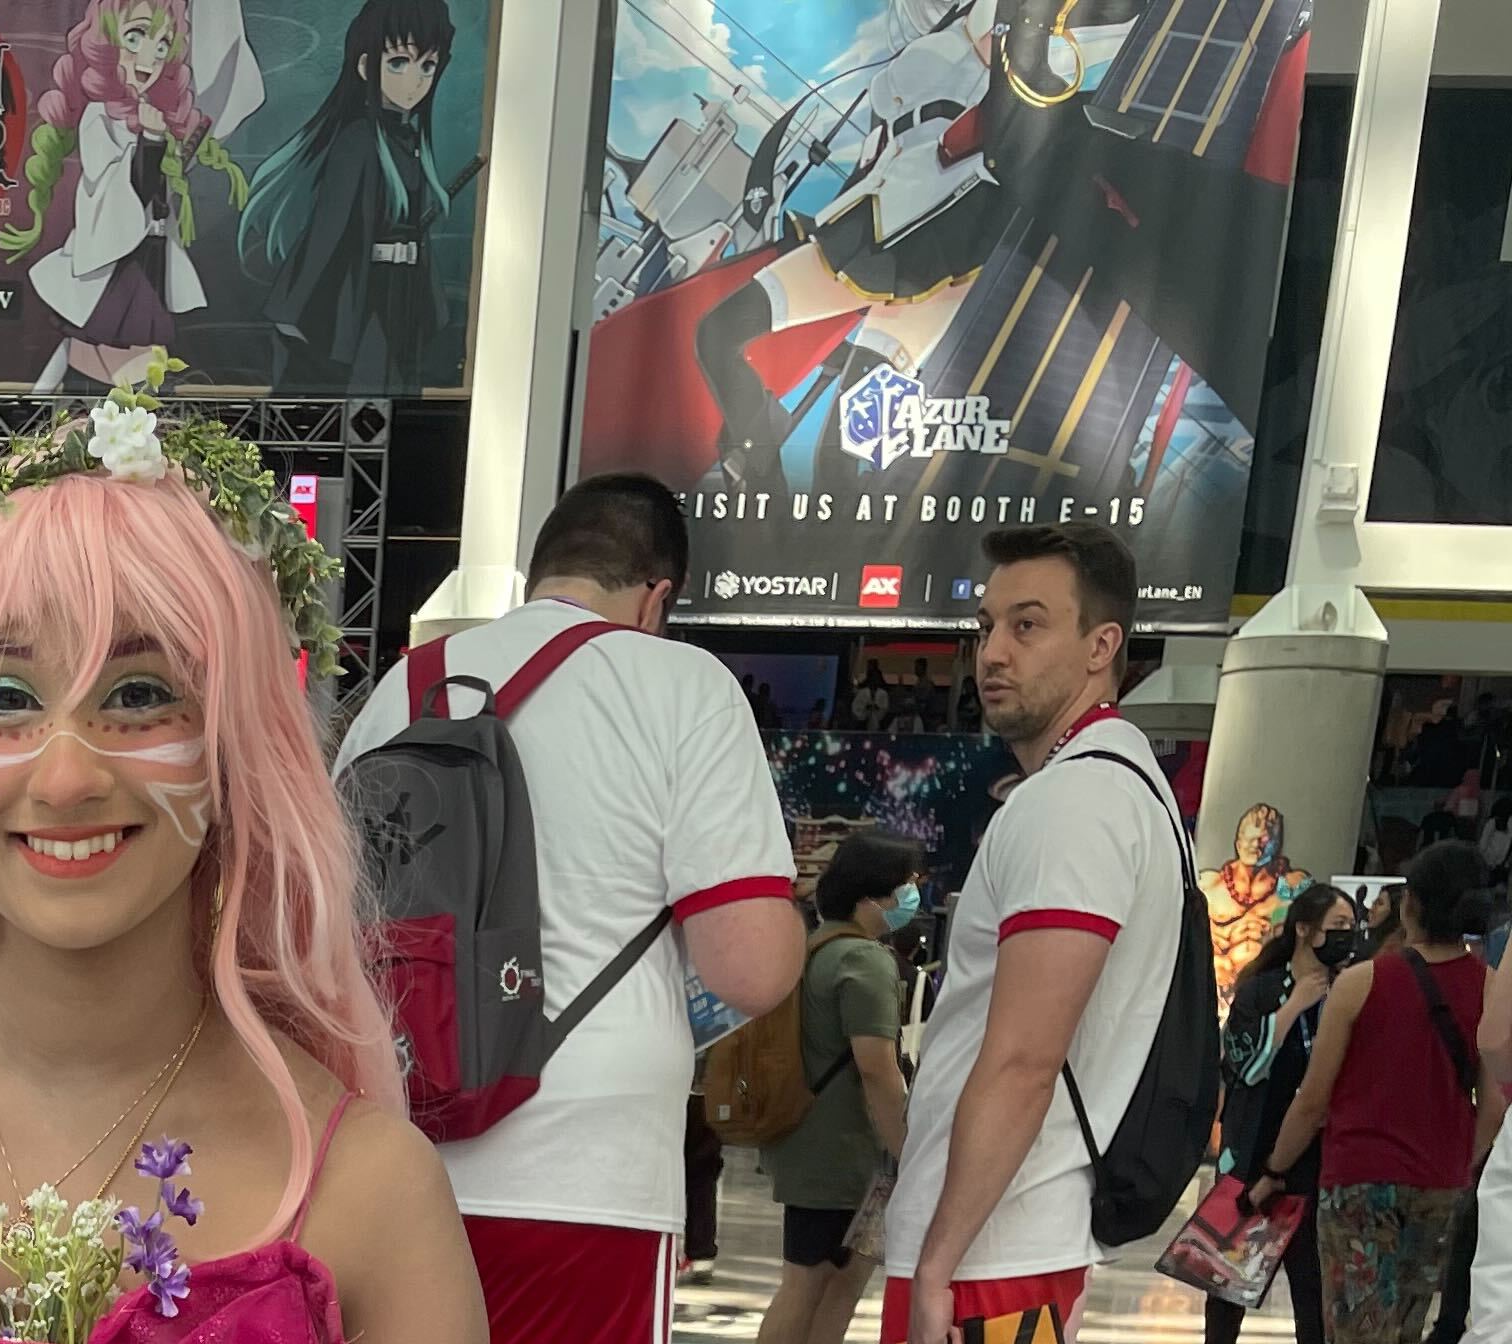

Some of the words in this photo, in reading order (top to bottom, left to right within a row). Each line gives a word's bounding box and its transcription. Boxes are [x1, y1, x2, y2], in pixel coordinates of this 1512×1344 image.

[892, 394, 991, 430] AZUR
[910, 420, 1011, 458] LANE
[678, 492, 770, 519] ISIT
[792, 493, 834, 521] US
[855, 494, 898, 522] AT
[920, 495, 1036, 523] BOOTH
[1059, 497, 1145, 525] E-15
[741, 575, 828, 597] YOSTAR
[861, 577, 901, 596] AX
